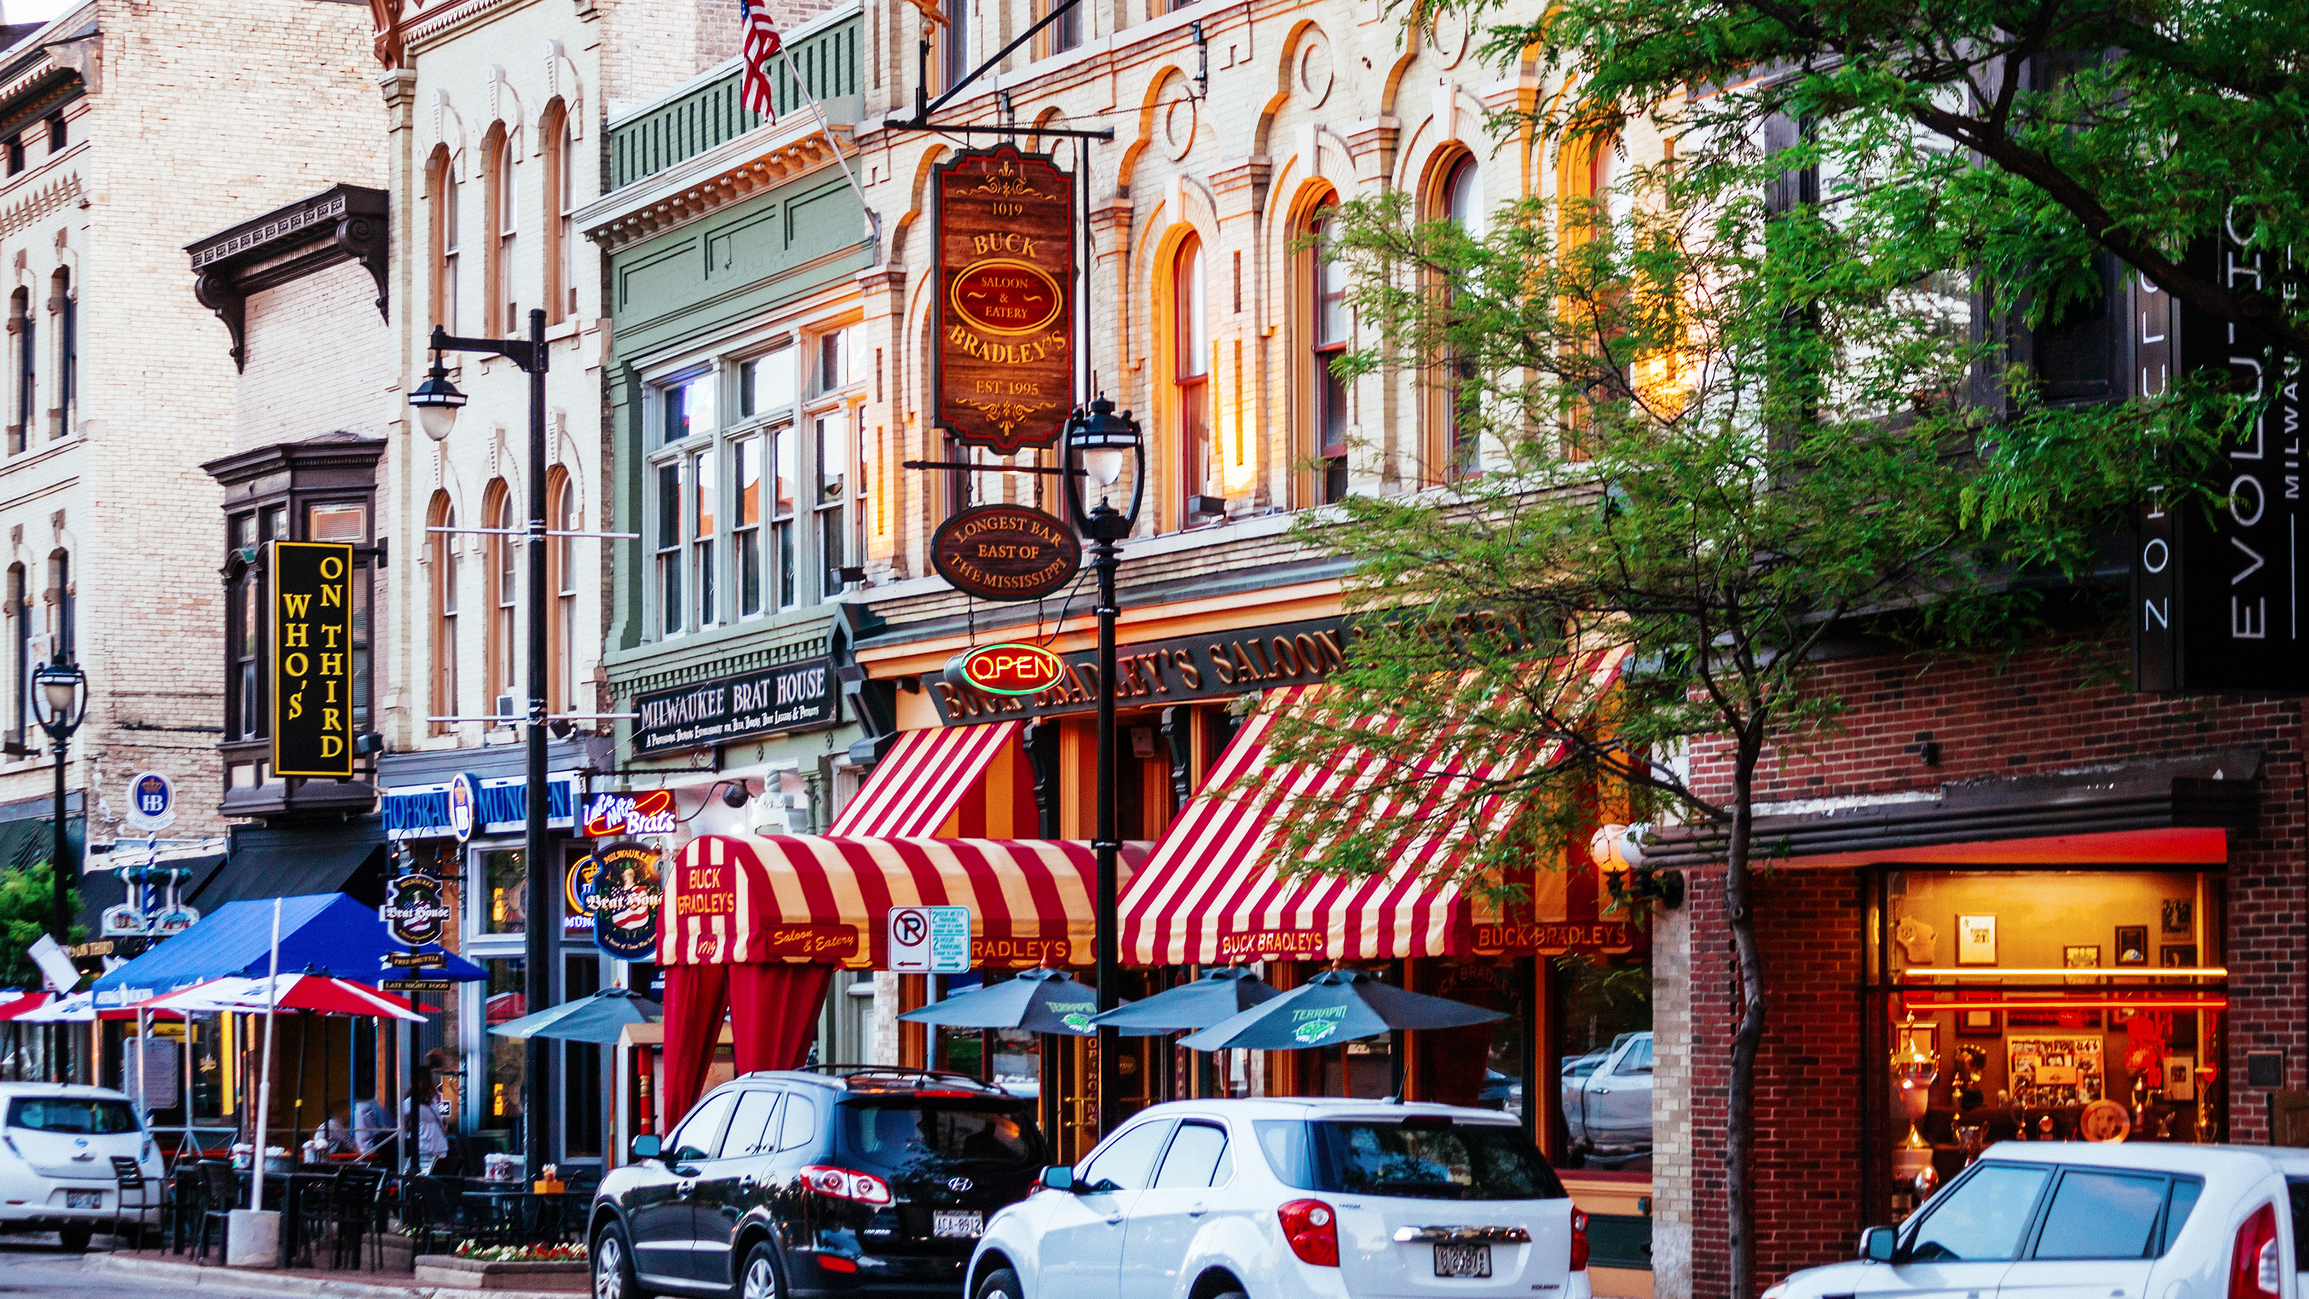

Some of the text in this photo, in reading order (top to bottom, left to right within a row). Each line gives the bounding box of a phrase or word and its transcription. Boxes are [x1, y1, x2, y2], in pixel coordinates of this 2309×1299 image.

[992, 202, 1023, 216] 1019
[973, 232, 1038, 258] BUCK
[981, 275, 1029, 289] SALOON
[999, 293, 1008, 303] &
[985, 307, 1029, 320] EATERY
[949, 324, 1067, 364] BRADLEY'S
[1009, 381, 1039, 396] 1995
[954, 516, 1062, 548] LONGEST BAR
[978, 544, 1039, 559] EAST OF
[950, 553, 1067, 589] THE MISSISSIPPI
[283, 594, 311, 721] WHO'S
[320, 556, 344, 758] ON THIRD
[1208, 629, 1350, 685] SALOON
[972, 655, 1054, 680] OPEN
[641, 667, 825, 729] MILWAUKEE BRAT HOUSE
[142, 795, 164, 811] HB
[626, 810, 676, 835] Brats
[603, 849, 651, 865] MILWAUKEE
[689, 868, 720, 889] BUCK
[586, 891, 663, 910] Brat Hous
[678, 891, 734, 915] BRADLEY'S
[386, 905, 450, 919] Brat House
[932, 911, 938, 924] 2
[773, 929, 814, 946] Saloon
[803, 934, 855, 953] & Eatery
[933, 937, 939, 950] 2
[1222, 934, 1256, 954] BUCK
[1479, 926, 1528, 946] BUCK
[971, 939, 1067, 957] RADLEY'S
[1292, 1005, 1347, 1023] TERRAPIN
